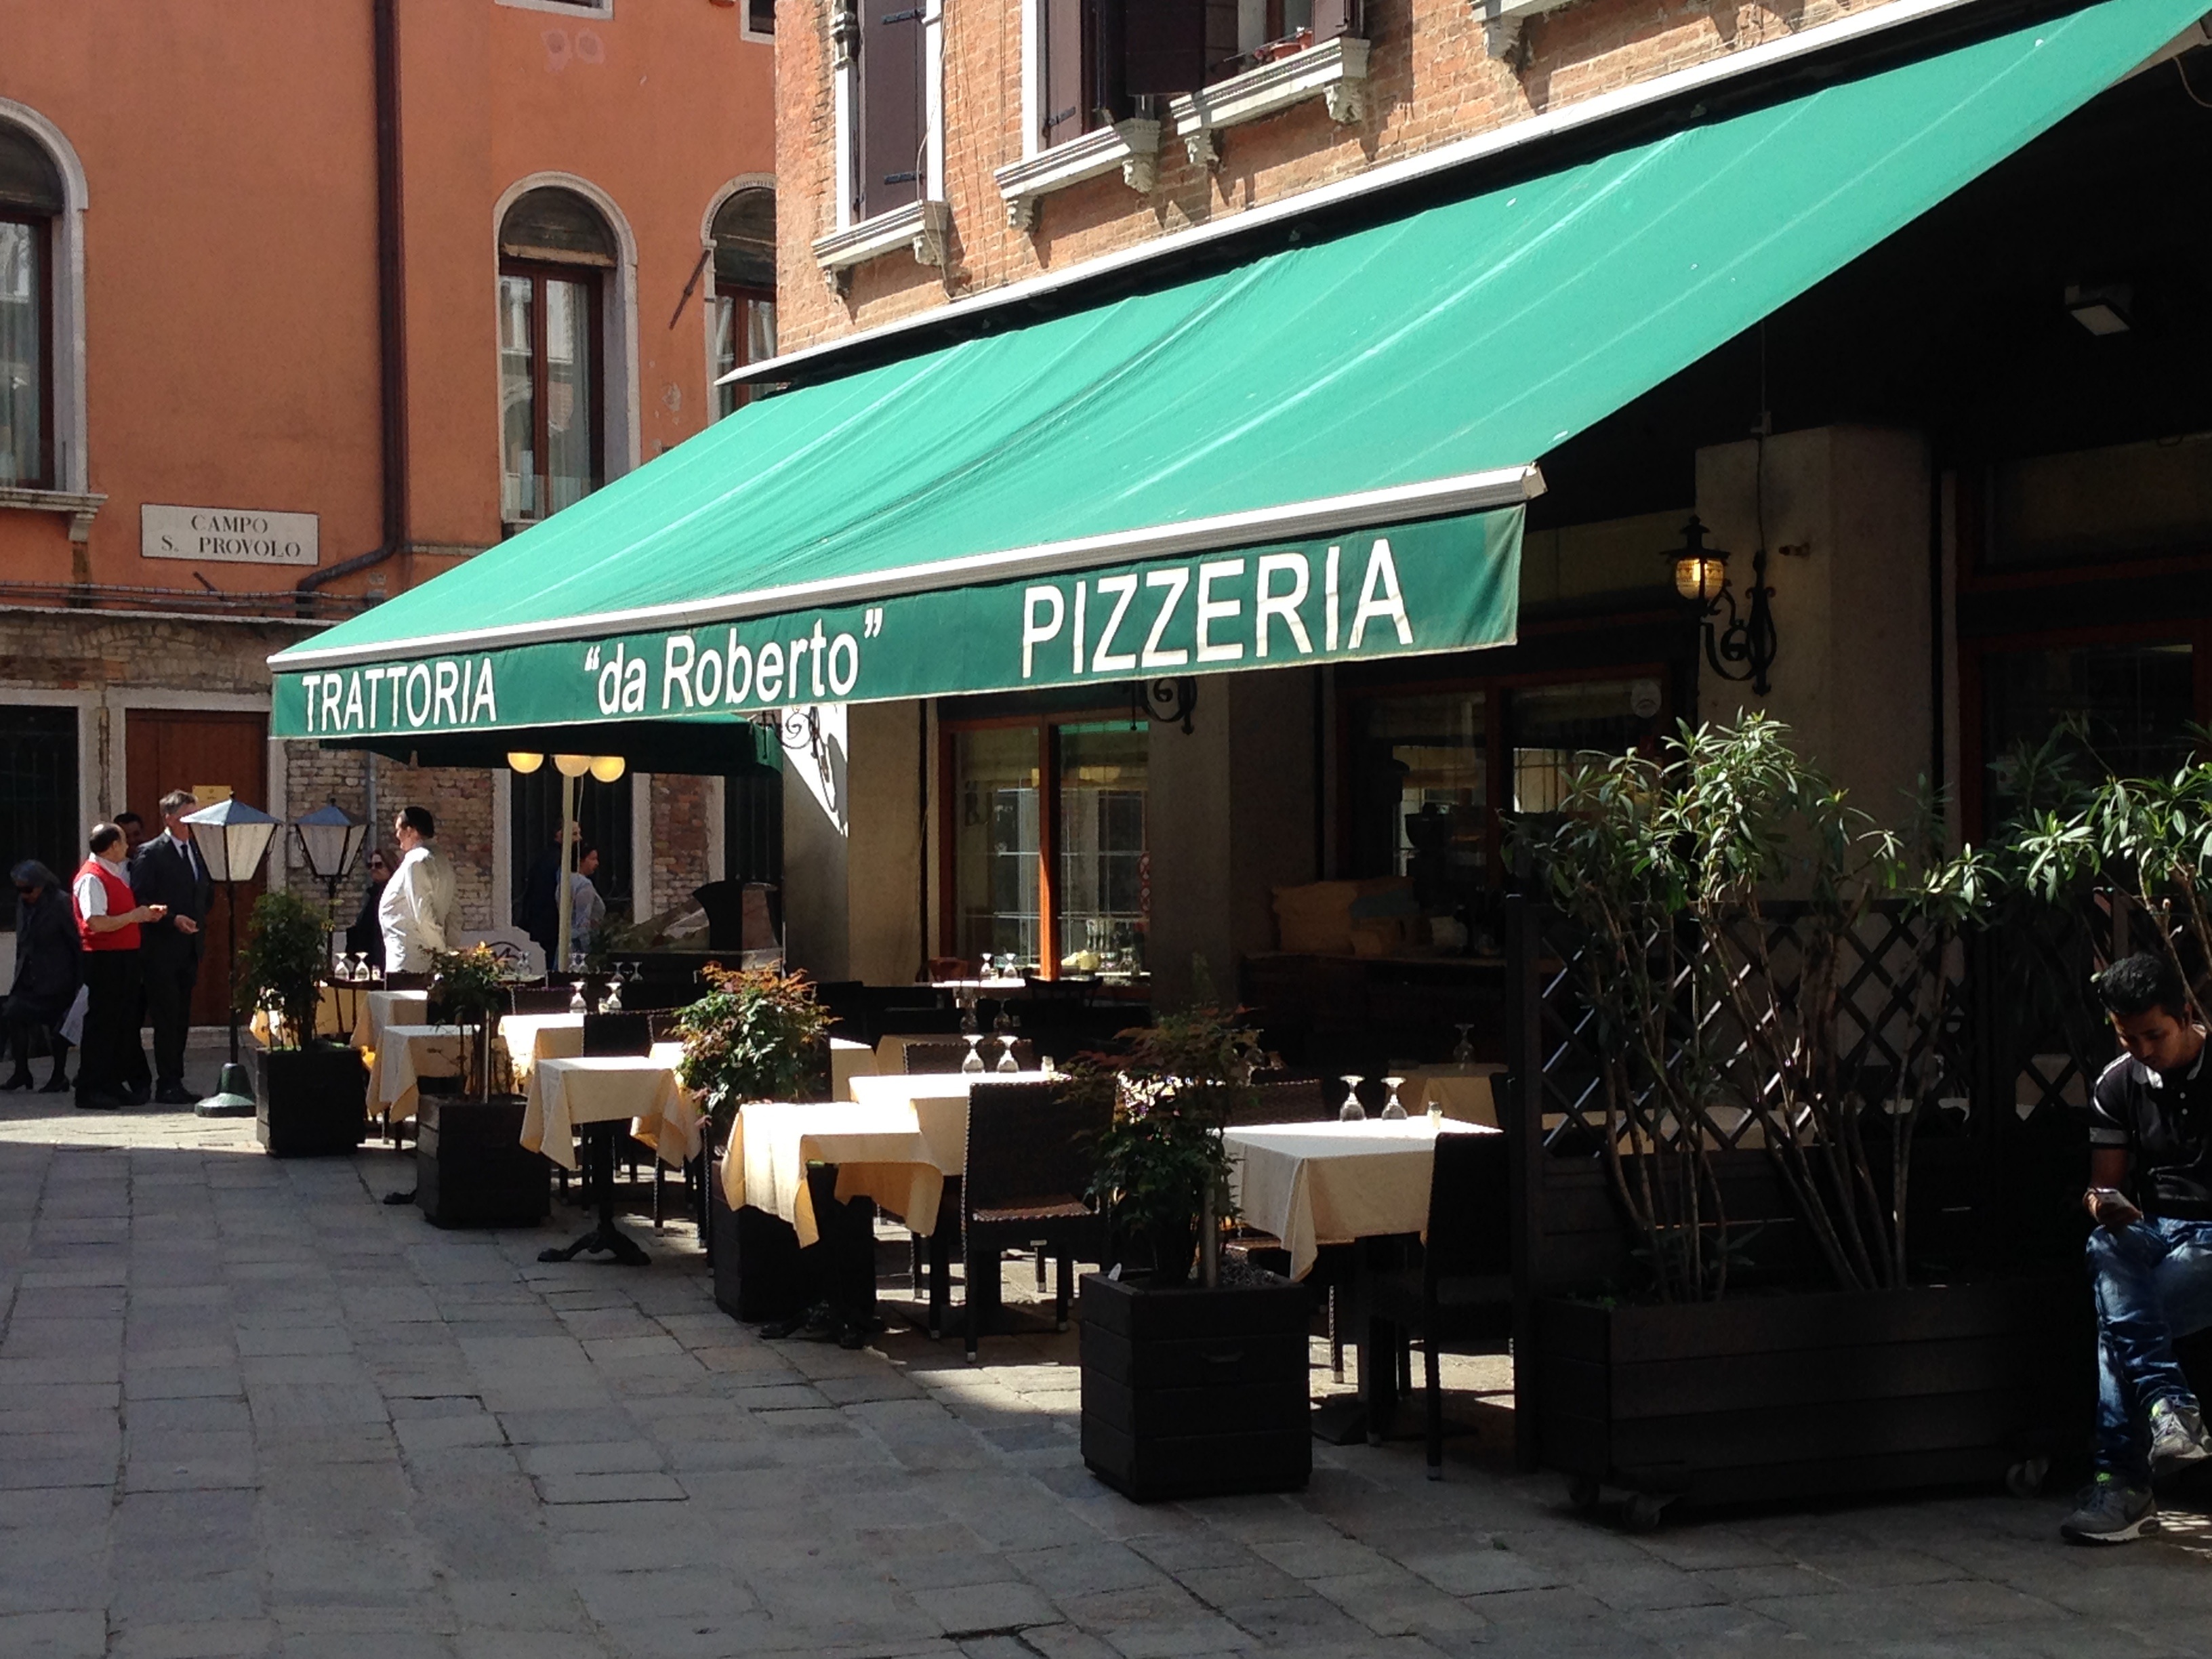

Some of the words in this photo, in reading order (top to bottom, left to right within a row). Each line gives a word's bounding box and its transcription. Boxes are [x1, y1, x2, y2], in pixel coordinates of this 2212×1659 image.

[191, 514, 268, 534] CAMPO
[161, 535, 179, 552] S.
[199, 537, 300, 557] PROVOLO
[302, 657, 497, 732] TRATTORIA
[1022, 538, 1414, 678] PIZZERIA
